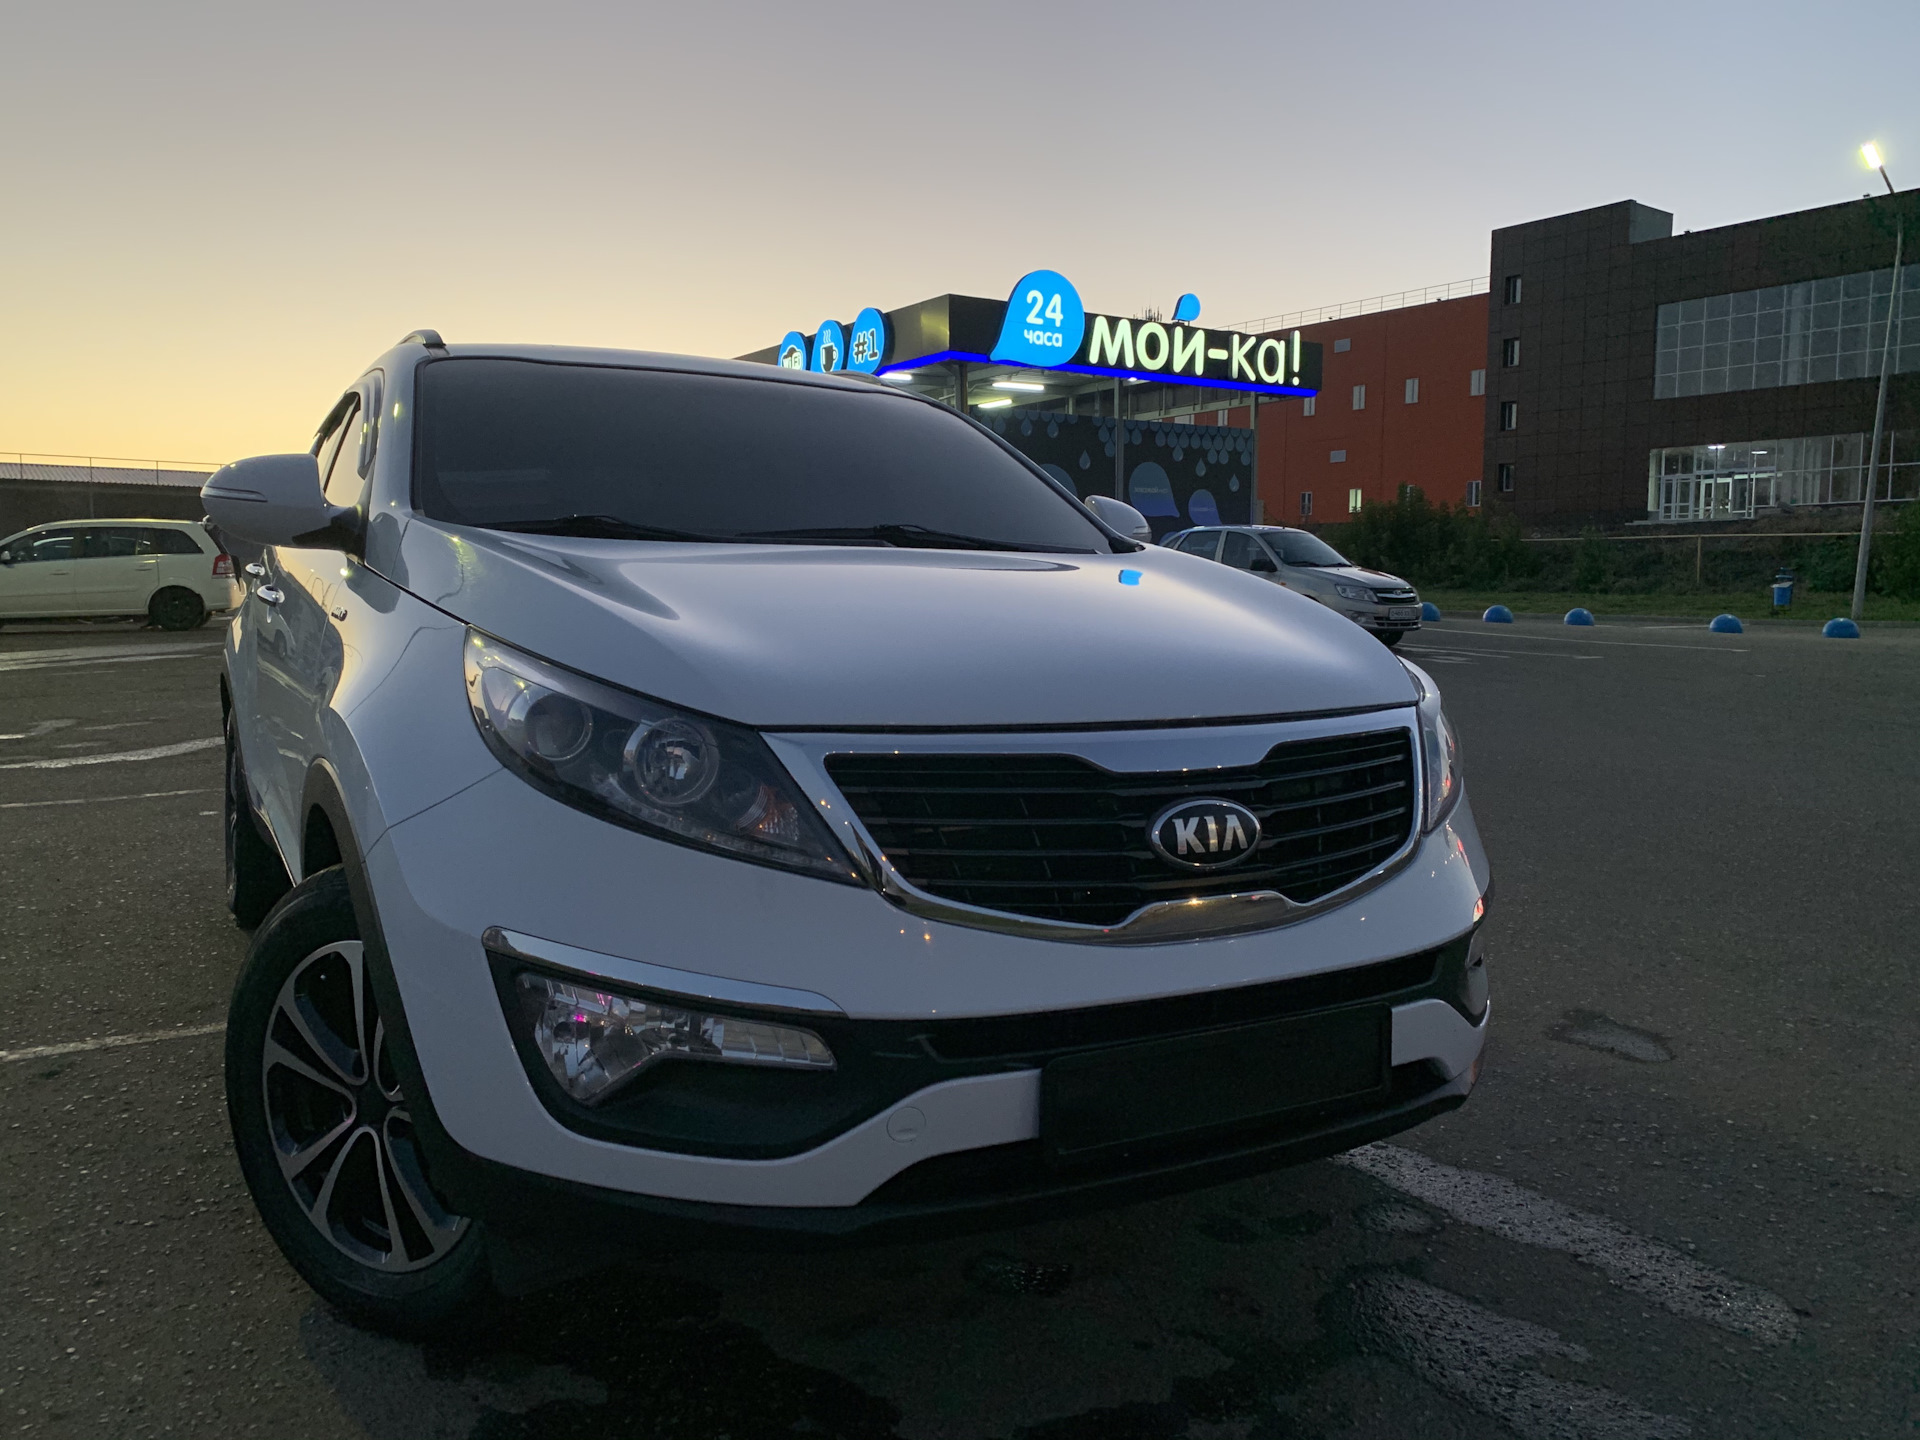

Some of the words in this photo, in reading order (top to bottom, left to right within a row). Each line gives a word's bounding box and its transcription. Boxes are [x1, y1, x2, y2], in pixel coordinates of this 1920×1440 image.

[1026, 289, 1064, 328] 24
[853, 328, 879, 364] #1
[1023, 328, 1063, 348] часа
[1171, 814, 1249, 855] KIA
